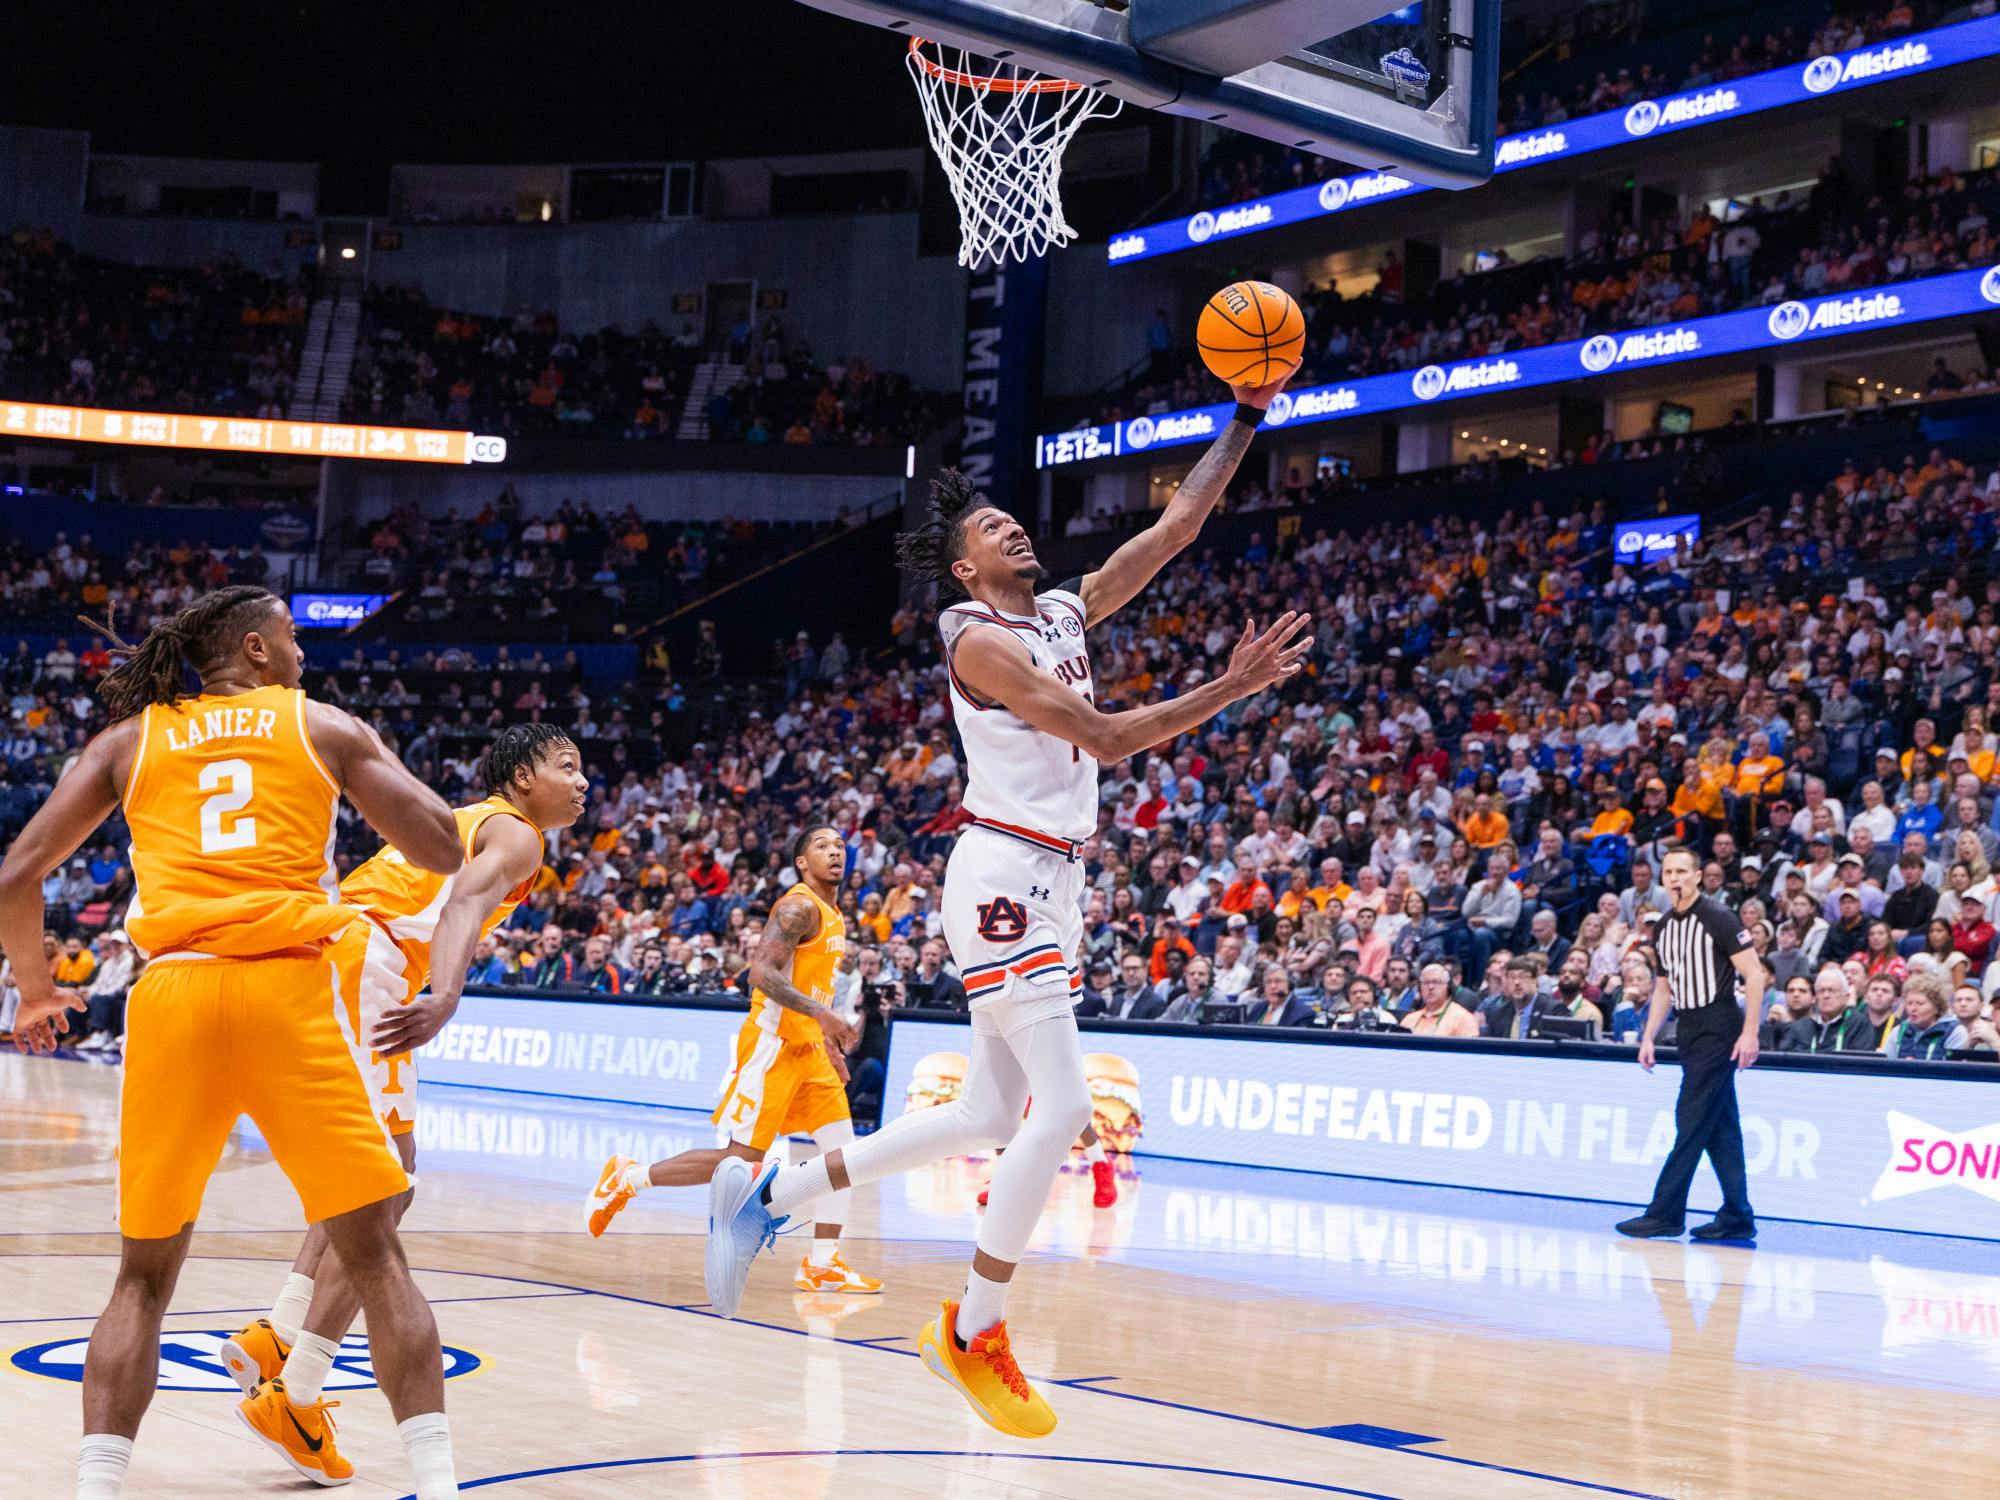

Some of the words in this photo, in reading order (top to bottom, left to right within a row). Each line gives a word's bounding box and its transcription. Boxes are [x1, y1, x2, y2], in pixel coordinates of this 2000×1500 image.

[1842, 42, 1928, 82] Allstate
[1659, 89, 1737, 126] Allstate
[1495, 131, 1566, 165] Allstate
[1213, 204, 1272, 235] Allstate
[1809, 293, 1901, 330] Allstate
[1616, 328, 1698, 363] Allstate
[1445, 359, 1518, 391] Allstate
[960, 326, 1002, 487] MEAN
[1291, 387, 1358, 418] Allstate
[6, 406, 27, 429] 2
[200, 420, 218, 442] 7
[289, 426, 312, 448] 11
[368, 430, 405, 454] 34
[1153, 413, 1213, 442] Allstate
[166, 708, 277, 751] LANIER
[198, 758, 257, 854] 2
[371, 1049, 411, 1094] T
[554, 1031, 585, 1070] IN
[589, 1034, 701, 1082] FLAVOR
[1170, 1075, 1493, 1151] UNDEFEATED
[1503, 1099, 1566, 1158] IN
[1579, 1103, 1821, 1181] FLAOR
